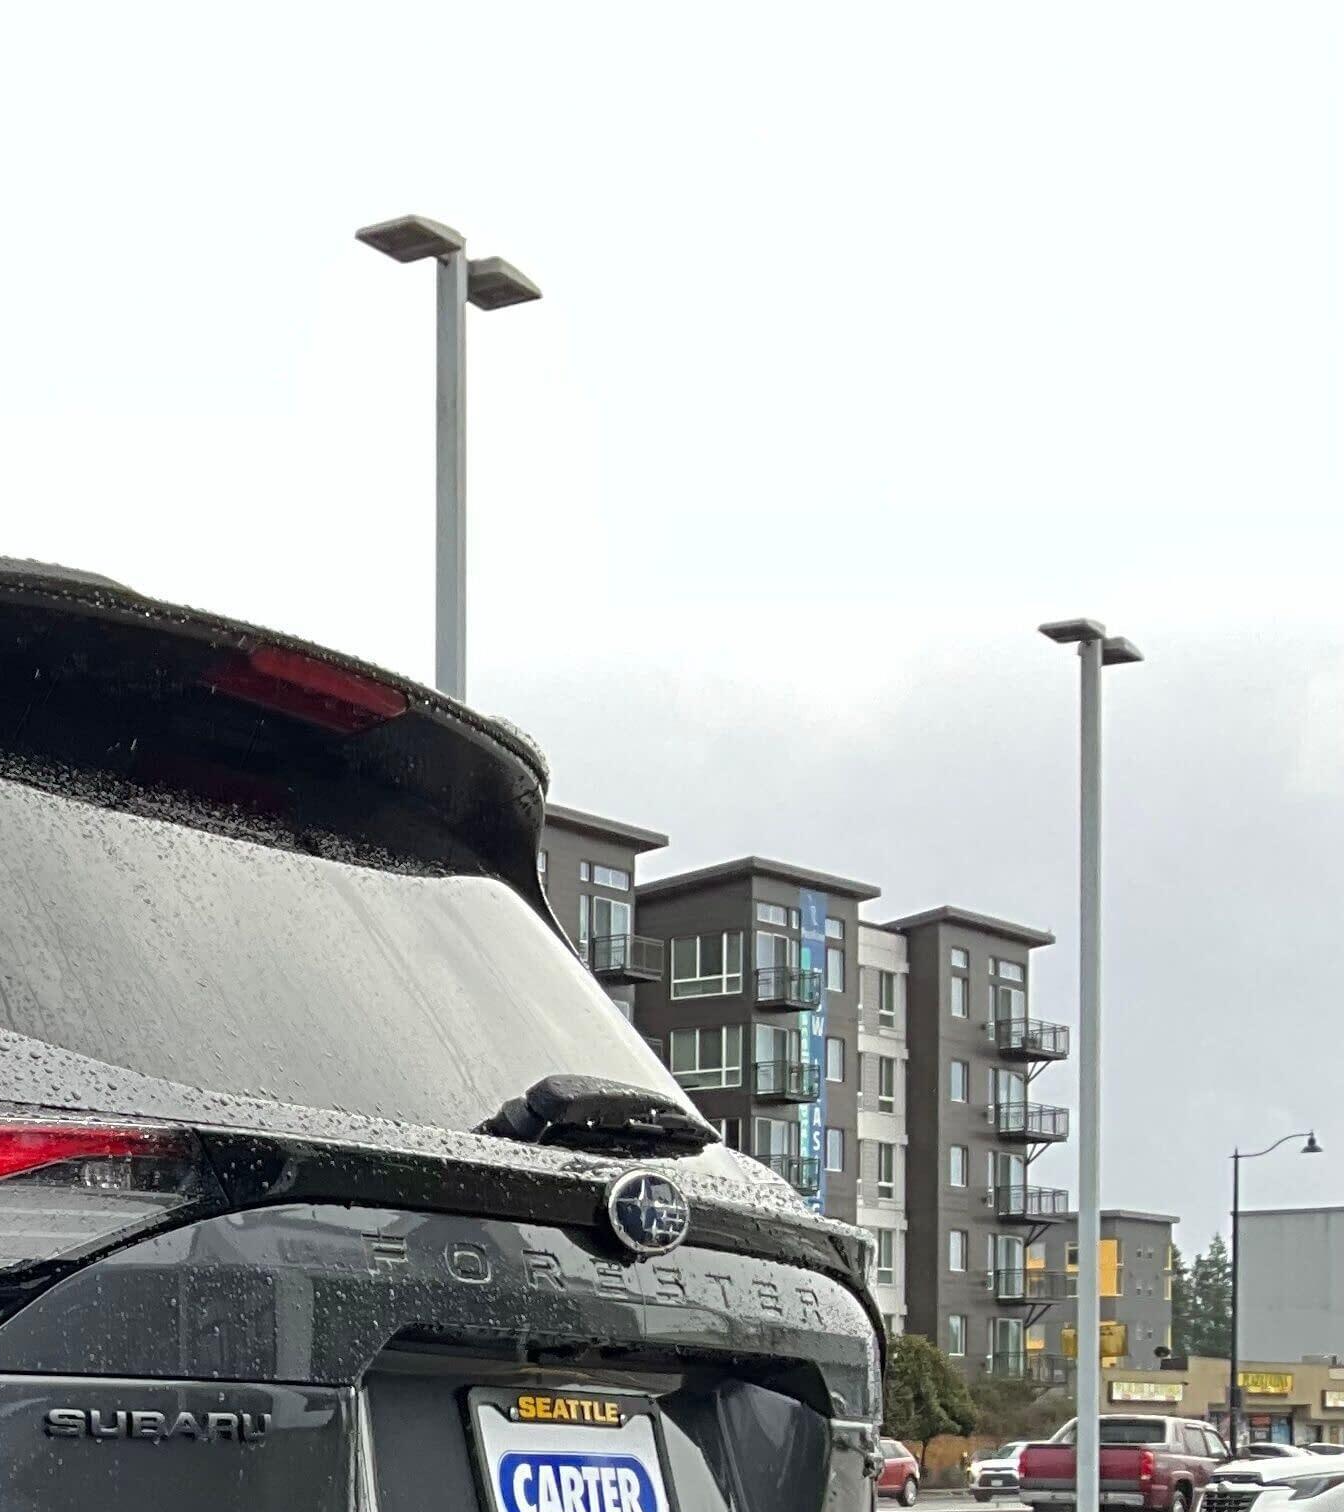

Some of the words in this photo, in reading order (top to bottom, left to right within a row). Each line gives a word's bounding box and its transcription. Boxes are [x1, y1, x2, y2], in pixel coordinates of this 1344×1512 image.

[360, 1228, 827, 1328] FORESTER
[43, 1408, 273, 1440] SUBARU
[517, 1395, 619, 1423] SEATTLE
